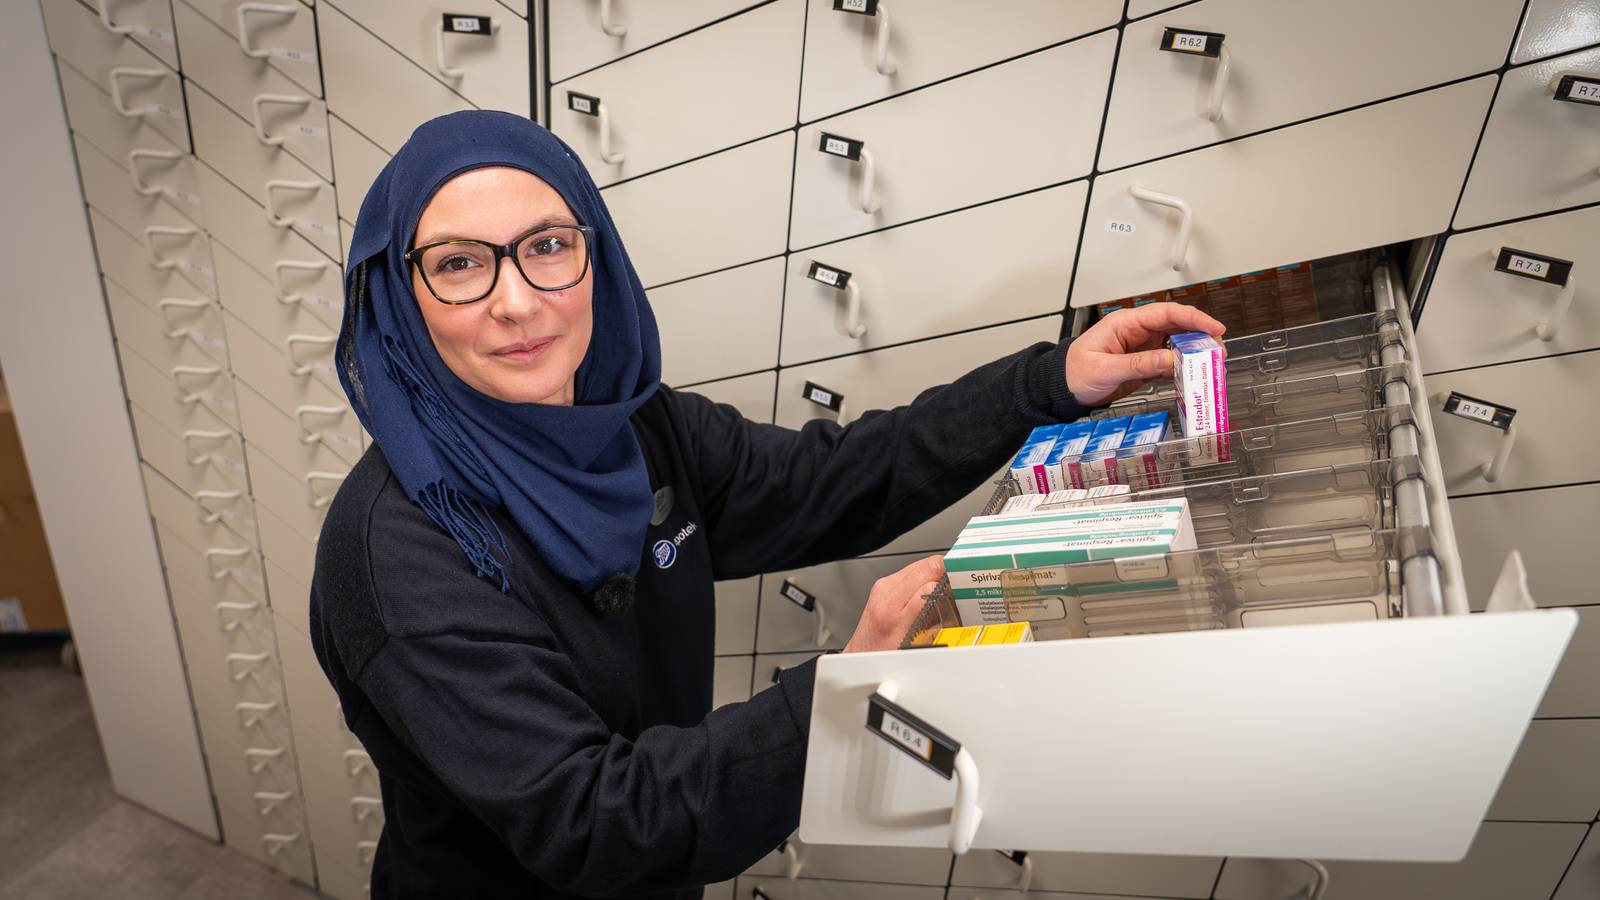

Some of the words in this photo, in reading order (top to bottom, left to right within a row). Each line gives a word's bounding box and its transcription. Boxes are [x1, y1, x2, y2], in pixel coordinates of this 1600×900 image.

[1188, 38, 1202, 47] 6.2
[1590, 87, 1600, 98] 7.
[970, 572, 1001, 584] Spiriva
